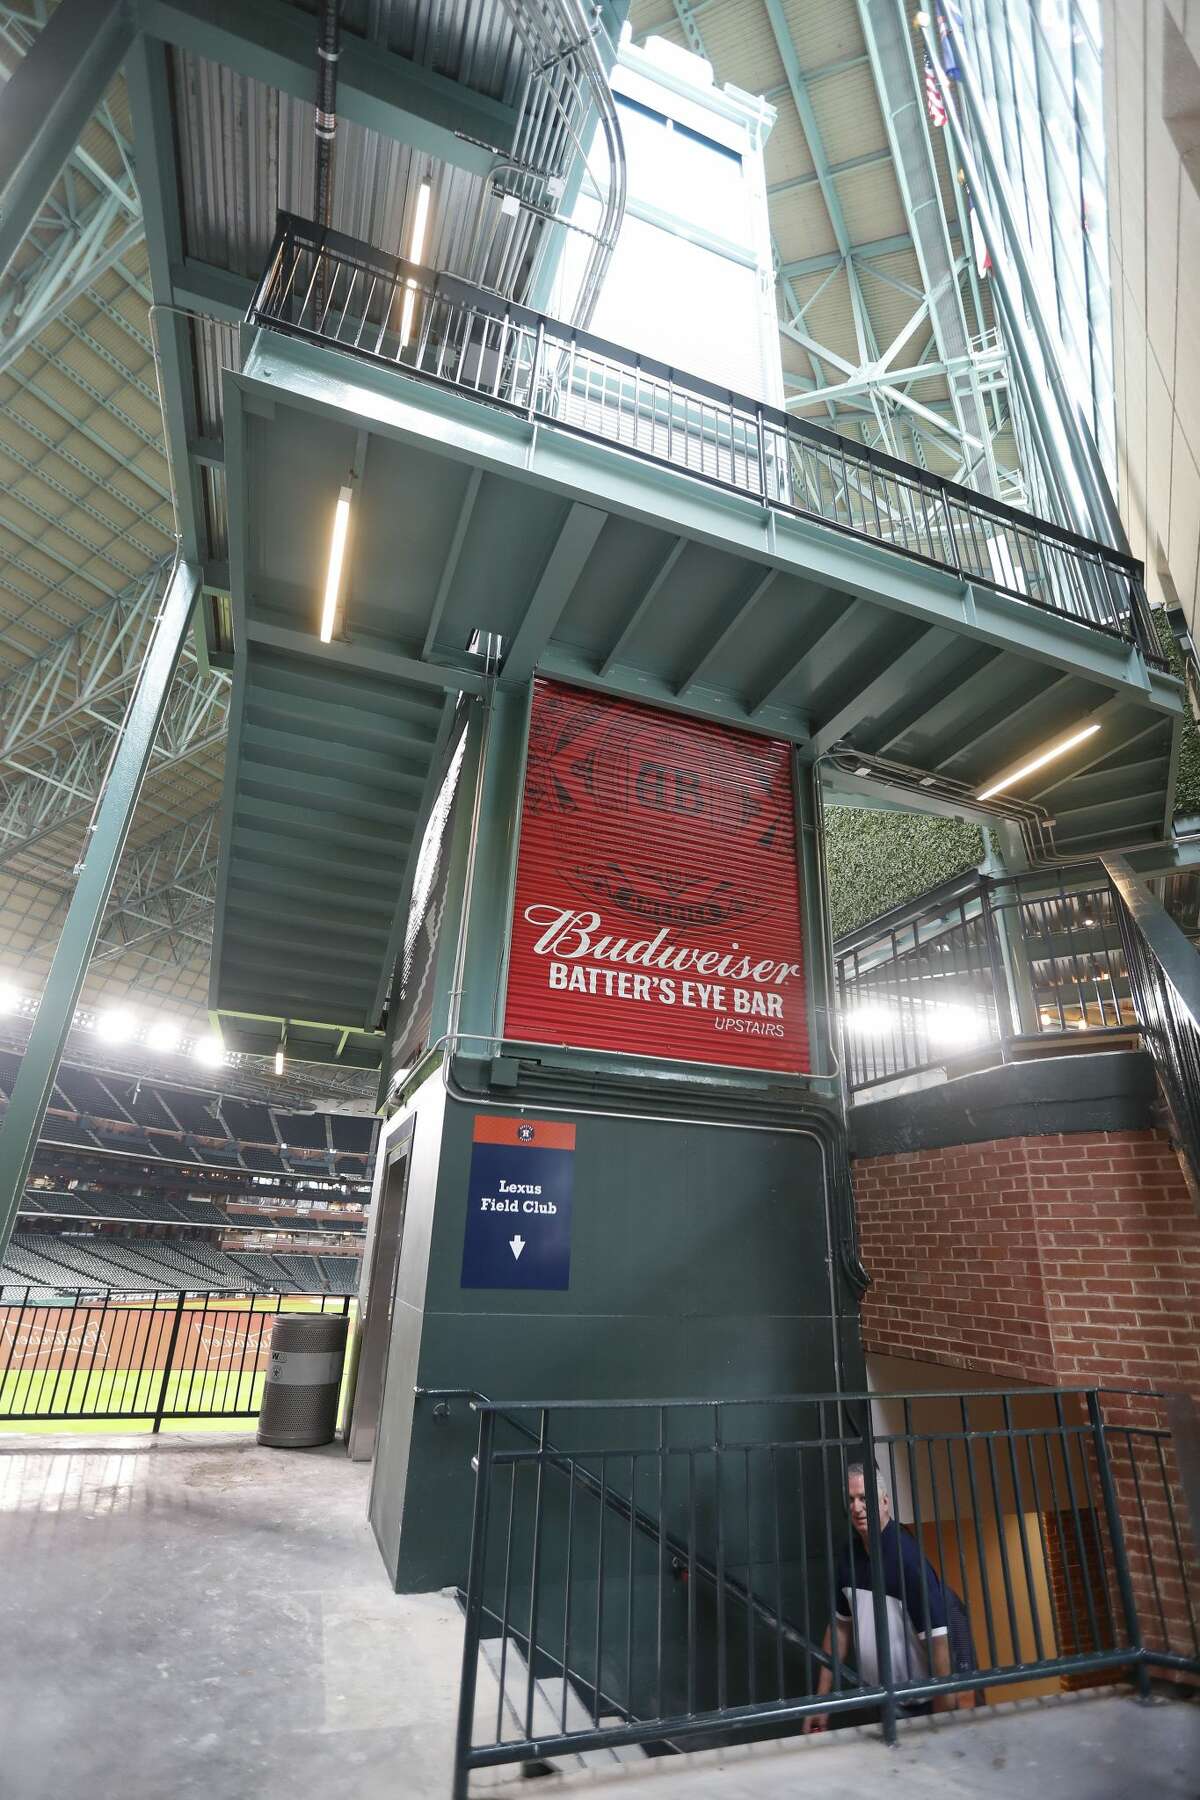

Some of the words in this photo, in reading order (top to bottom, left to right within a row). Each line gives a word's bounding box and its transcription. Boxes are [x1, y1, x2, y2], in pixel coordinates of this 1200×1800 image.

[523, 903, 801, 985] Budweiser
[549, 962, 677, 1006] BATTER'S
[681, 981, 728, 1012] EYE
[733, 988, 784, 1019] BAR
[714, 1016, 785, 1038] UPSTAIRS
[498, 1180, 542, 1195] Lexus
[480, 1198, 519, 1213] Field
[522, 1200, 558, 1215] Club
